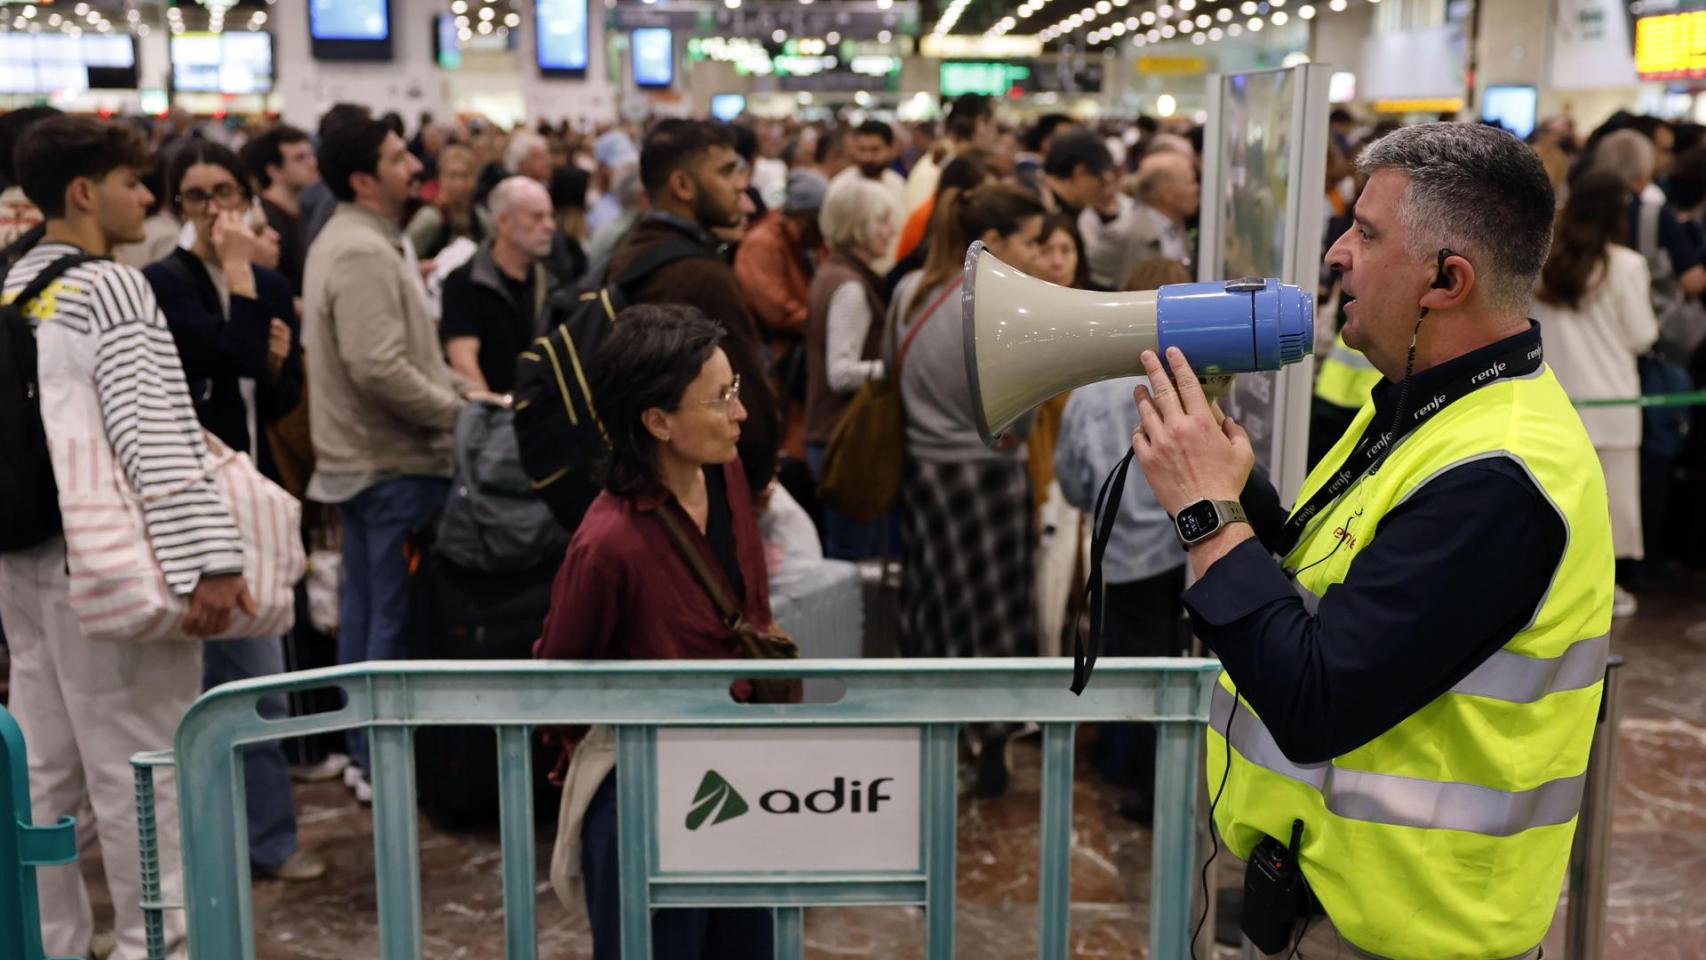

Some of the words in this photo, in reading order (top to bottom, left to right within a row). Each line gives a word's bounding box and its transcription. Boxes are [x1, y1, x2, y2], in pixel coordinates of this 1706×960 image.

[1527, 343, 1542, 361] renf
[1471, 361, 1507, 384] renfe
[1413, 394, 1447, 420] renfe
[1328, 470, 1351, 494] renfe
[759, 776, 894, 814] adif
